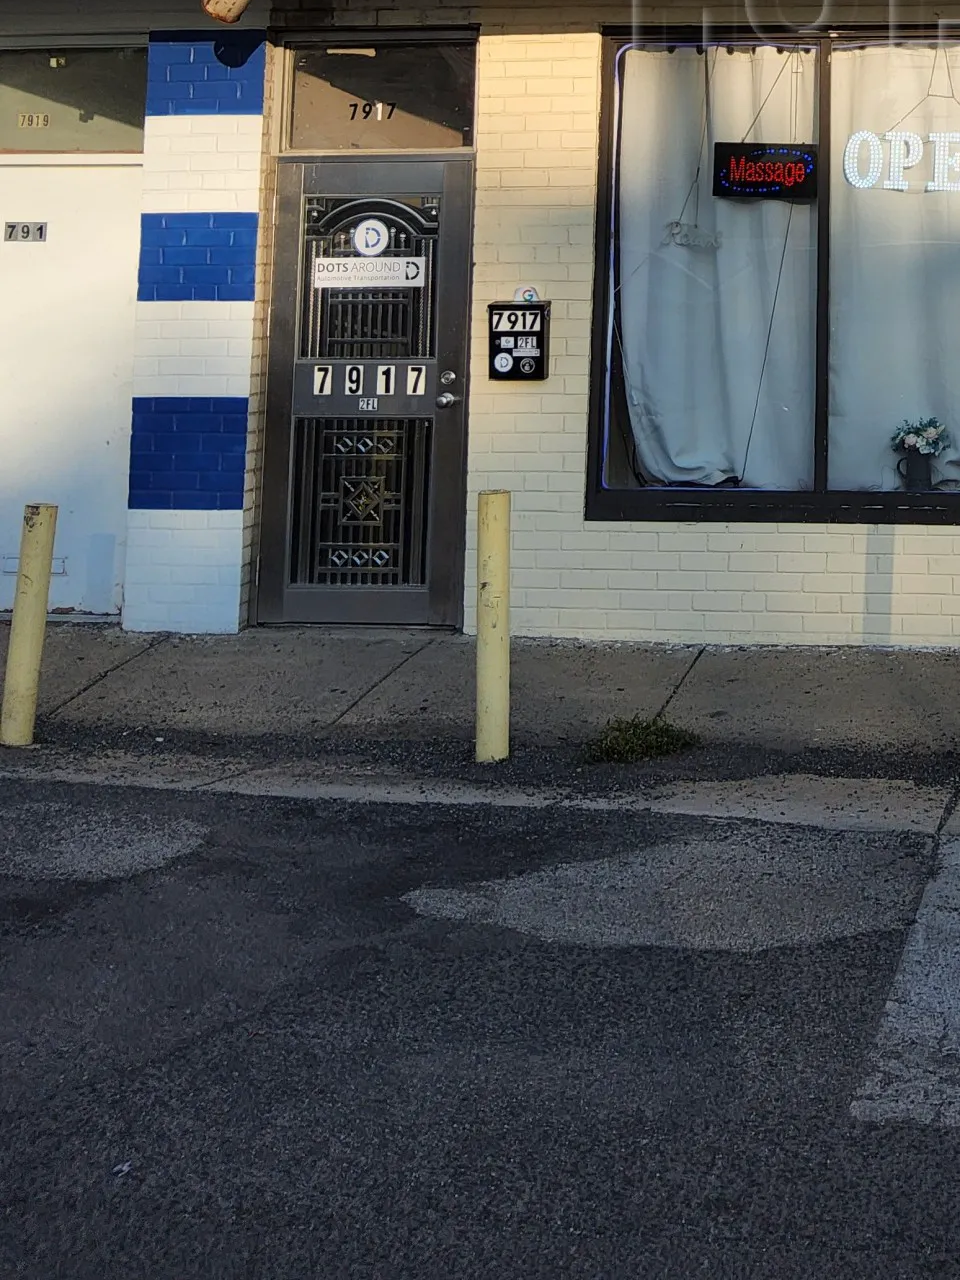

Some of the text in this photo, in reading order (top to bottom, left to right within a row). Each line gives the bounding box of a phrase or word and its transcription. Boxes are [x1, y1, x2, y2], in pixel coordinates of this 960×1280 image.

[349, 102, 397, 121] 7917
[20, 114, 49, 127] 7919
[730, 156, 805, 186] Massage
[7, 224, 44, 240] 791
[317, 261, 400, 273] DOTS AROUND
[354, 274, 400, 282] Transportation
[493, 312, 540, 330] 7917
[519, 337, 536, 348] 2FL
[360, 399, 377, 410] 2FL
